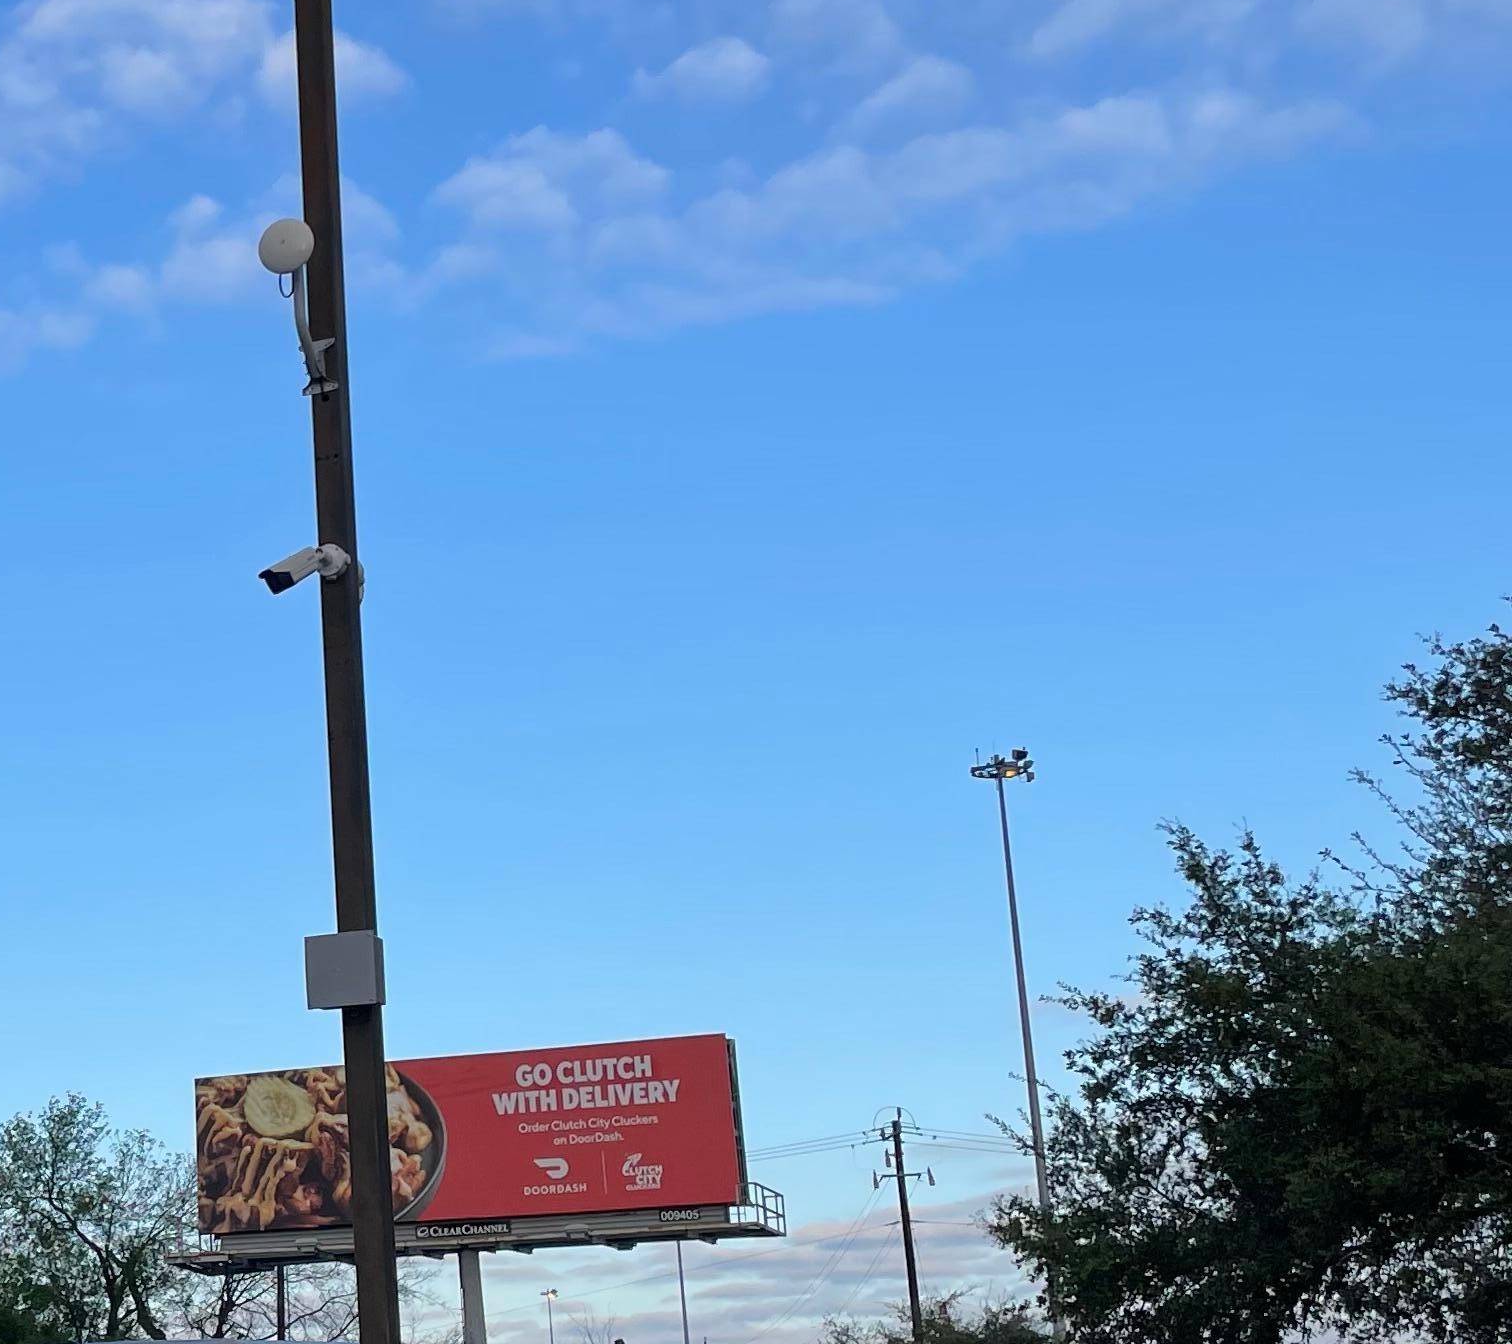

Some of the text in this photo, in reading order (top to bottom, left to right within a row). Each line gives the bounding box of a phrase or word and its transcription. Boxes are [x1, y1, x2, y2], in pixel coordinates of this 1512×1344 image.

[515, 1055, 653, 1087] GO CLUTCH
[492, 1079, 680, 1116] WITH DELIVERY
[518, 1114, 659, 1134] Order Clutch City Cluckers
[553, 1131, 625, 1146] on DoorDash.
[621, 1159, 663, 1176] CLUTCH
[635, 1175, 662, 1186] CITY
[523, 1182, 587, 1196] DOORDASH
[659, 1209, 700, 1222] 009405
